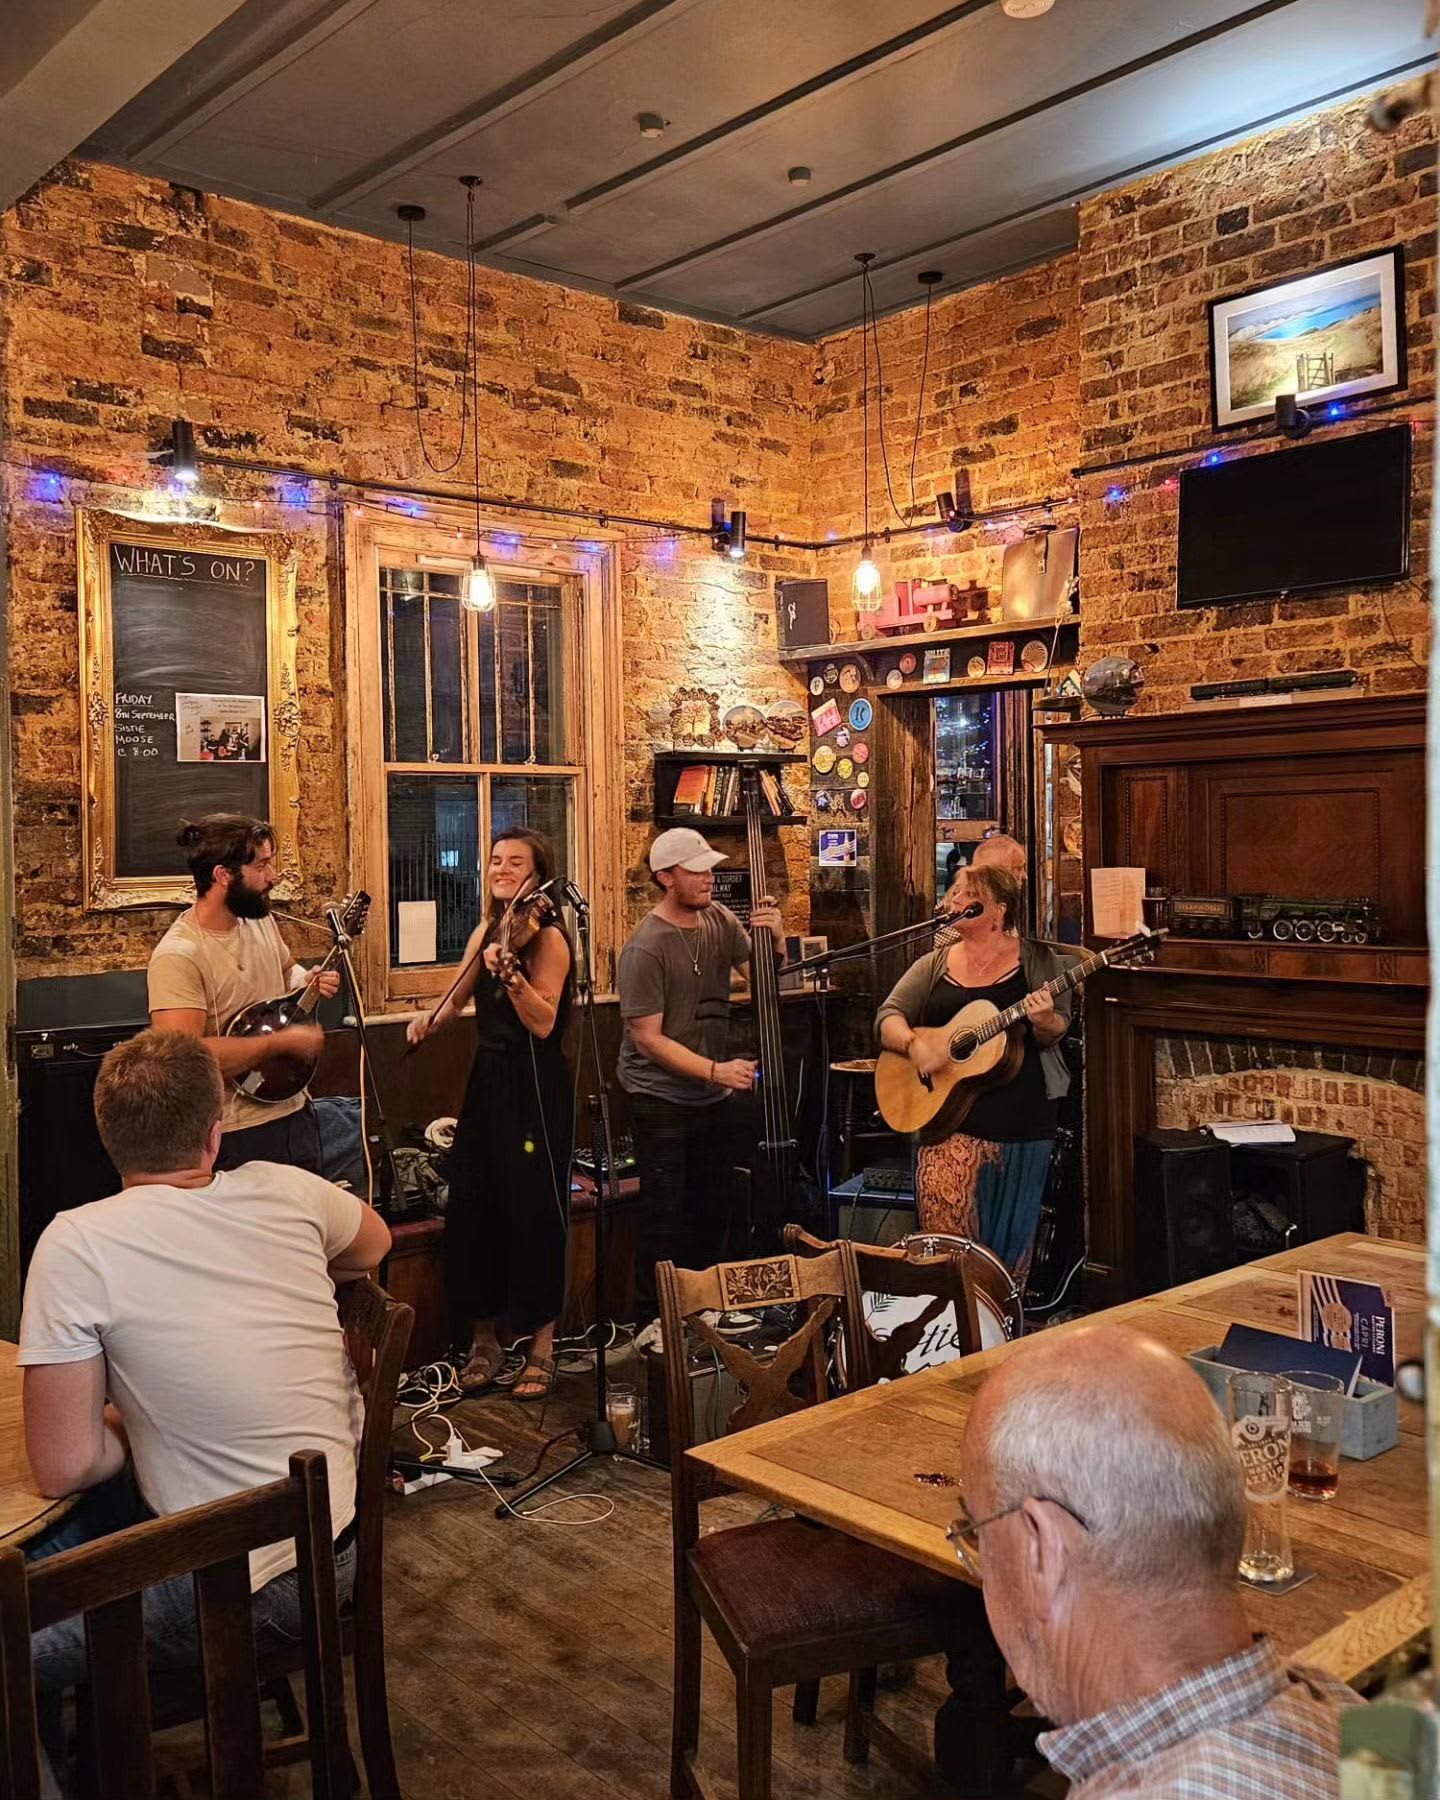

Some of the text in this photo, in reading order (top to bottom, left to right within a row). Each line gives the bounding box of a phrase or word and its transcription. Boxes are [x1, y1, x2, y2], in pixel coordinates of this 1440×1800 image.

[114, 545, 255, 581] WHAT'S ON?
[115, 692, 153, 705] FRIDAY
[131, 709, 175, 721] SEPTEMBER
[115, 735, 154, 745] MOOSE
[1361, 1317, 1369, 1348] CAPRI
[1375, 1316, 1386, 1355] PERONI
